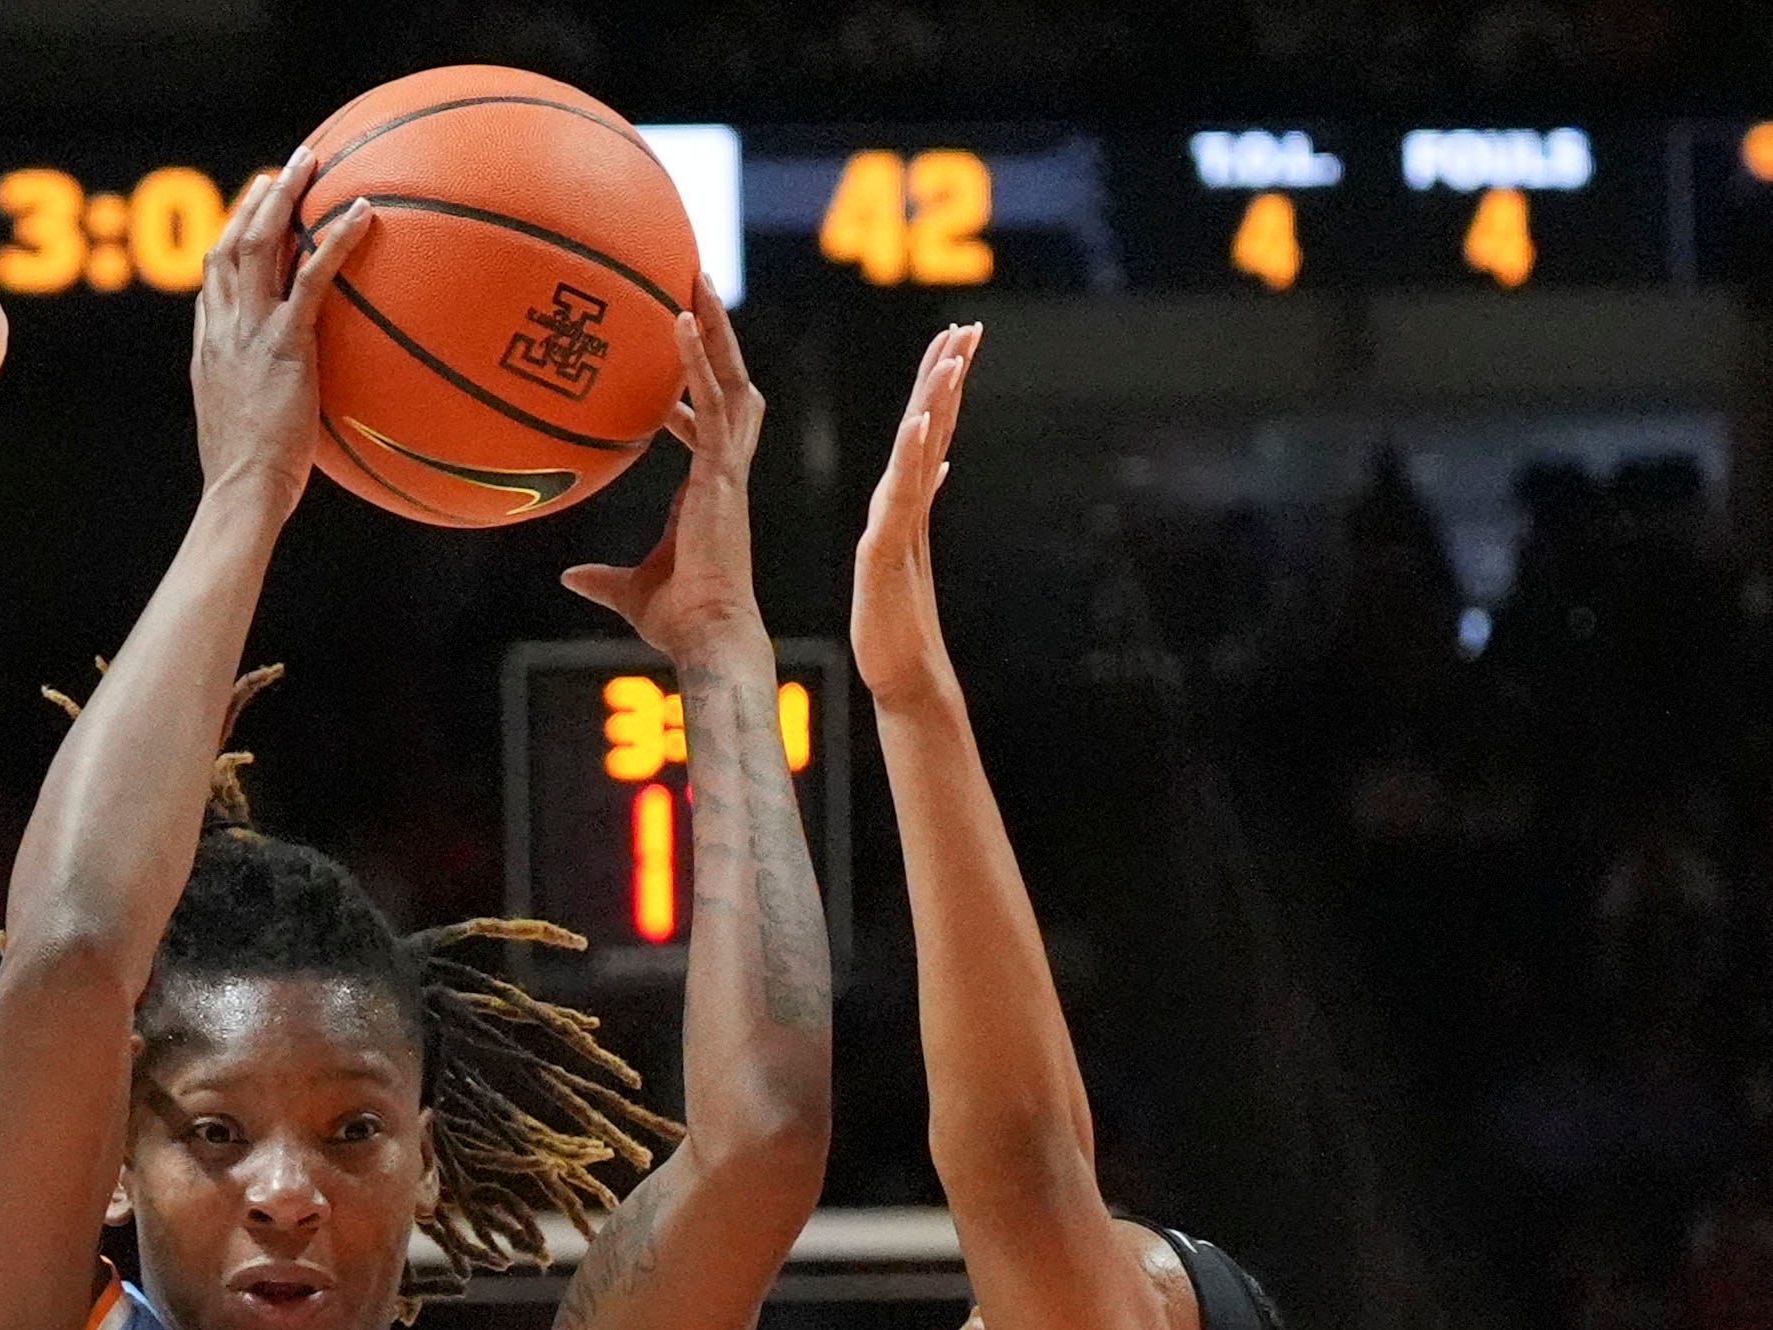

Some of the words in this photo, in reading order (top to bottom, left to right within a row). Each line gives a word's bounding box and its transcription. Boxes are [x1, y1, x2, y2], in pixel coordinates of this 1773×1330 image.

[820, 148, 993, 284] 42
[1233, 194, 1300, 289] 4
[1464, 189, 1537, 286] 4
